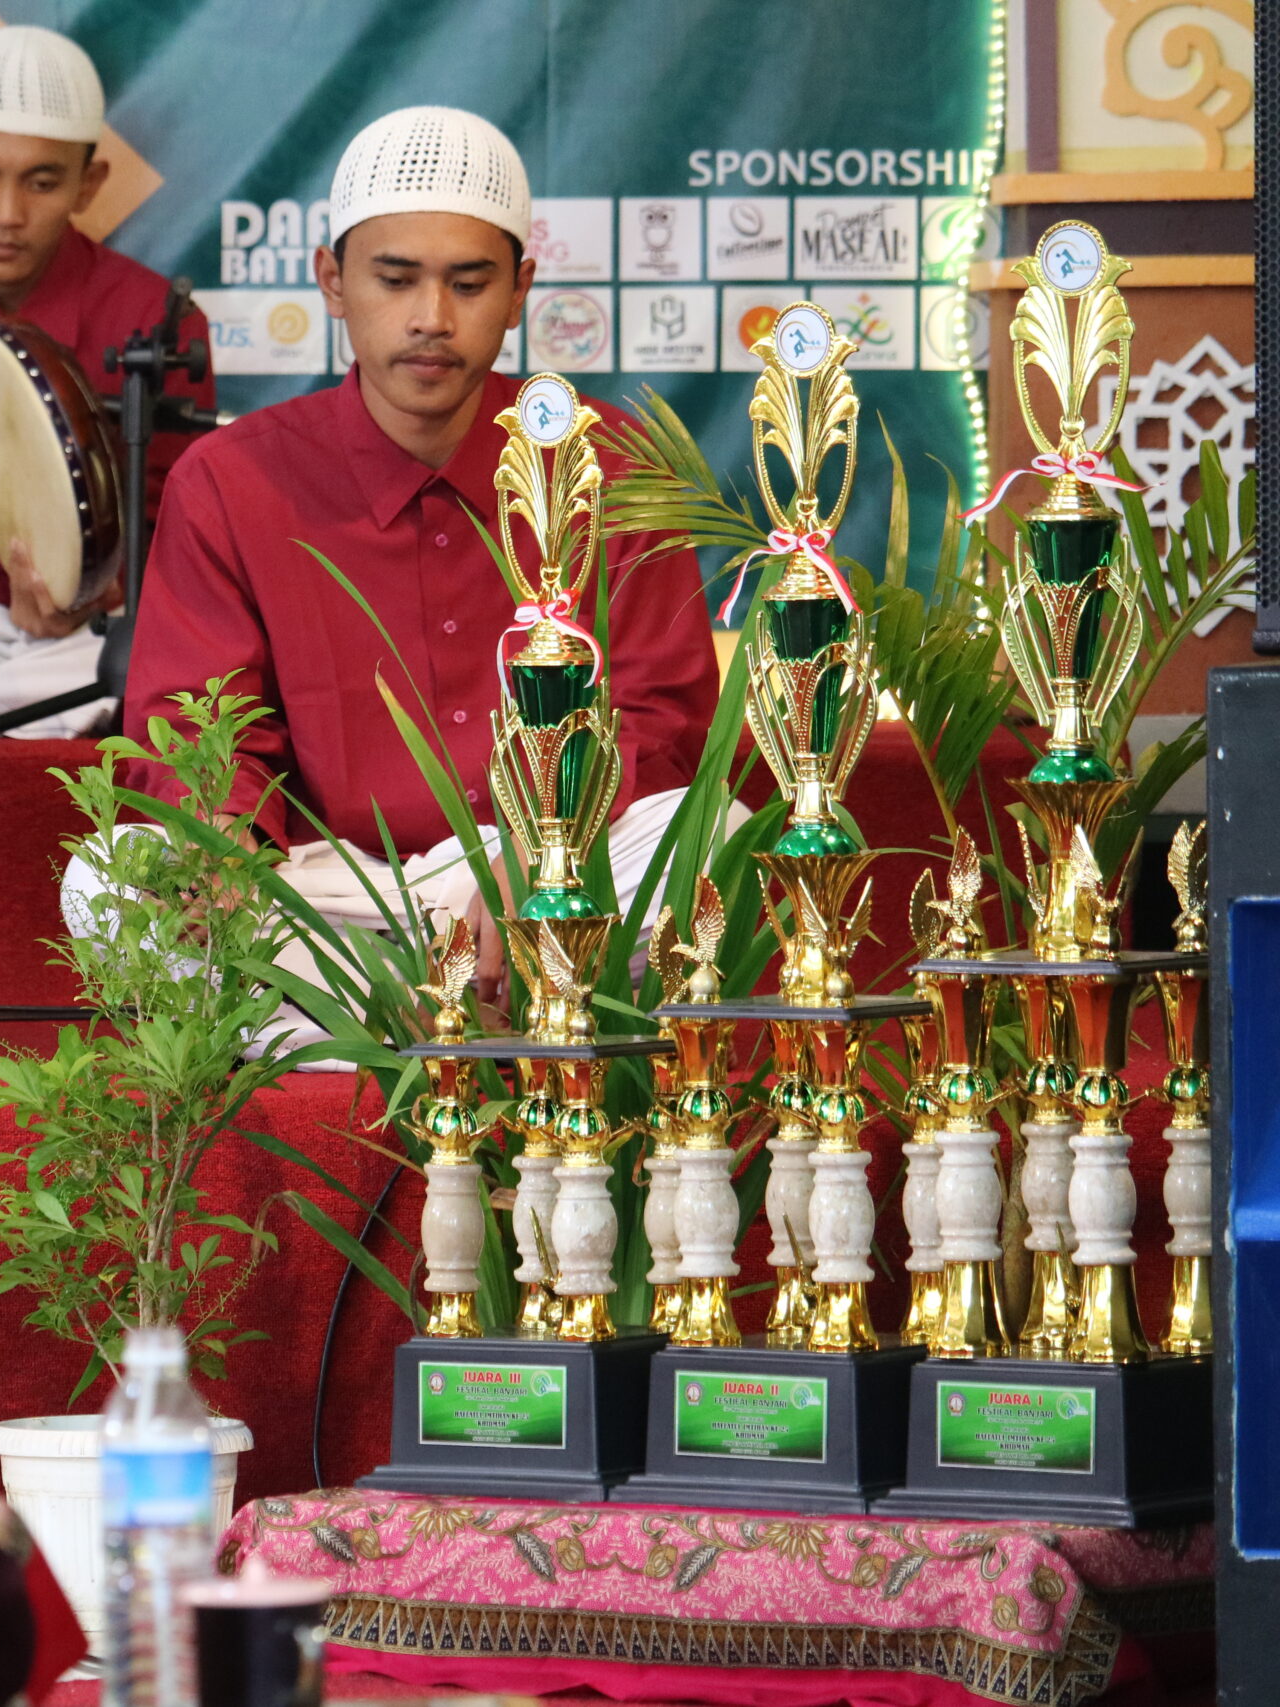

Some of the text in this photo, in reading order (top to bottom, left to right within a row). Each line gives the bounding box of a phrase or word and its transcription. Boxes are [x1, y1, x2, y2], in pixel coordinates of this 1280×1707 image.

[464, 1371, 521, 1384] JUARA III
[724, 1382, 779, 1396] JUARA II
[989, 1393, 1042, 1405] JUARA I
